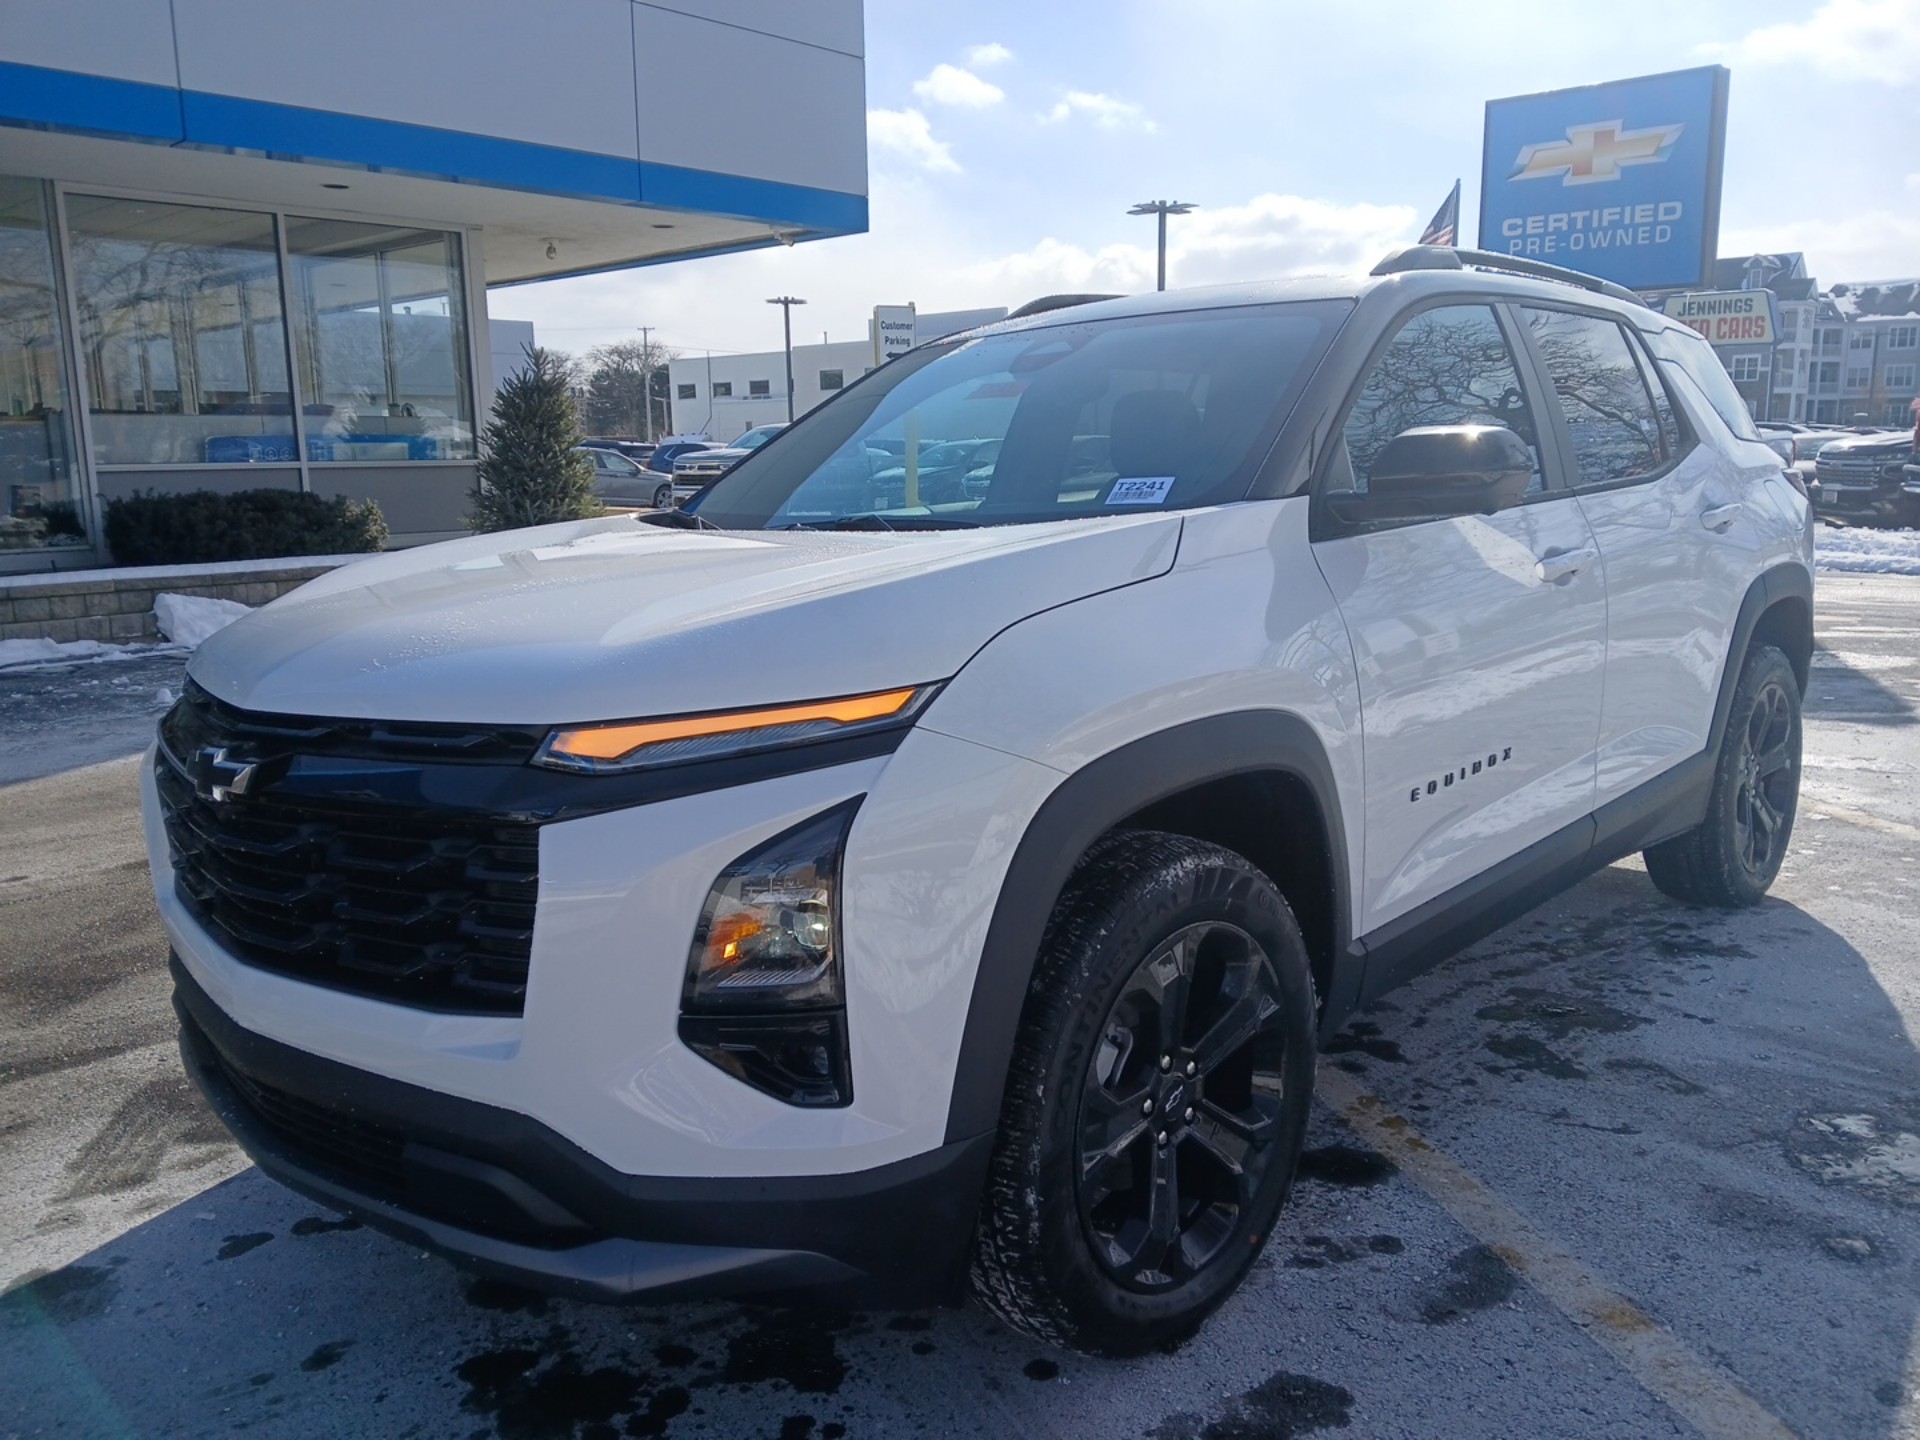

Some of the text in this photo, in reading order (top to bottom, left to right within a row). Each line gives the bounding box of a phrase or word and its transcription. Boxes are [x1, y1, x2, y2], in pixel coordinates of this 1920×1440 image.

[1502, 201, 1683, 237] CERTIFIED
[1509, 225, 1671, 256] PRE-OWNED
[1677, 297, 1754, 317] JENNINGS
[880, 320, 913, 330] Customer
[1716, 315, 1765, 340] CARS
[884, 335, 911, 347] Parking
[1118, 481, 1164, 491] T2241
[1410, 746, 1512, 802] EQUINOX
